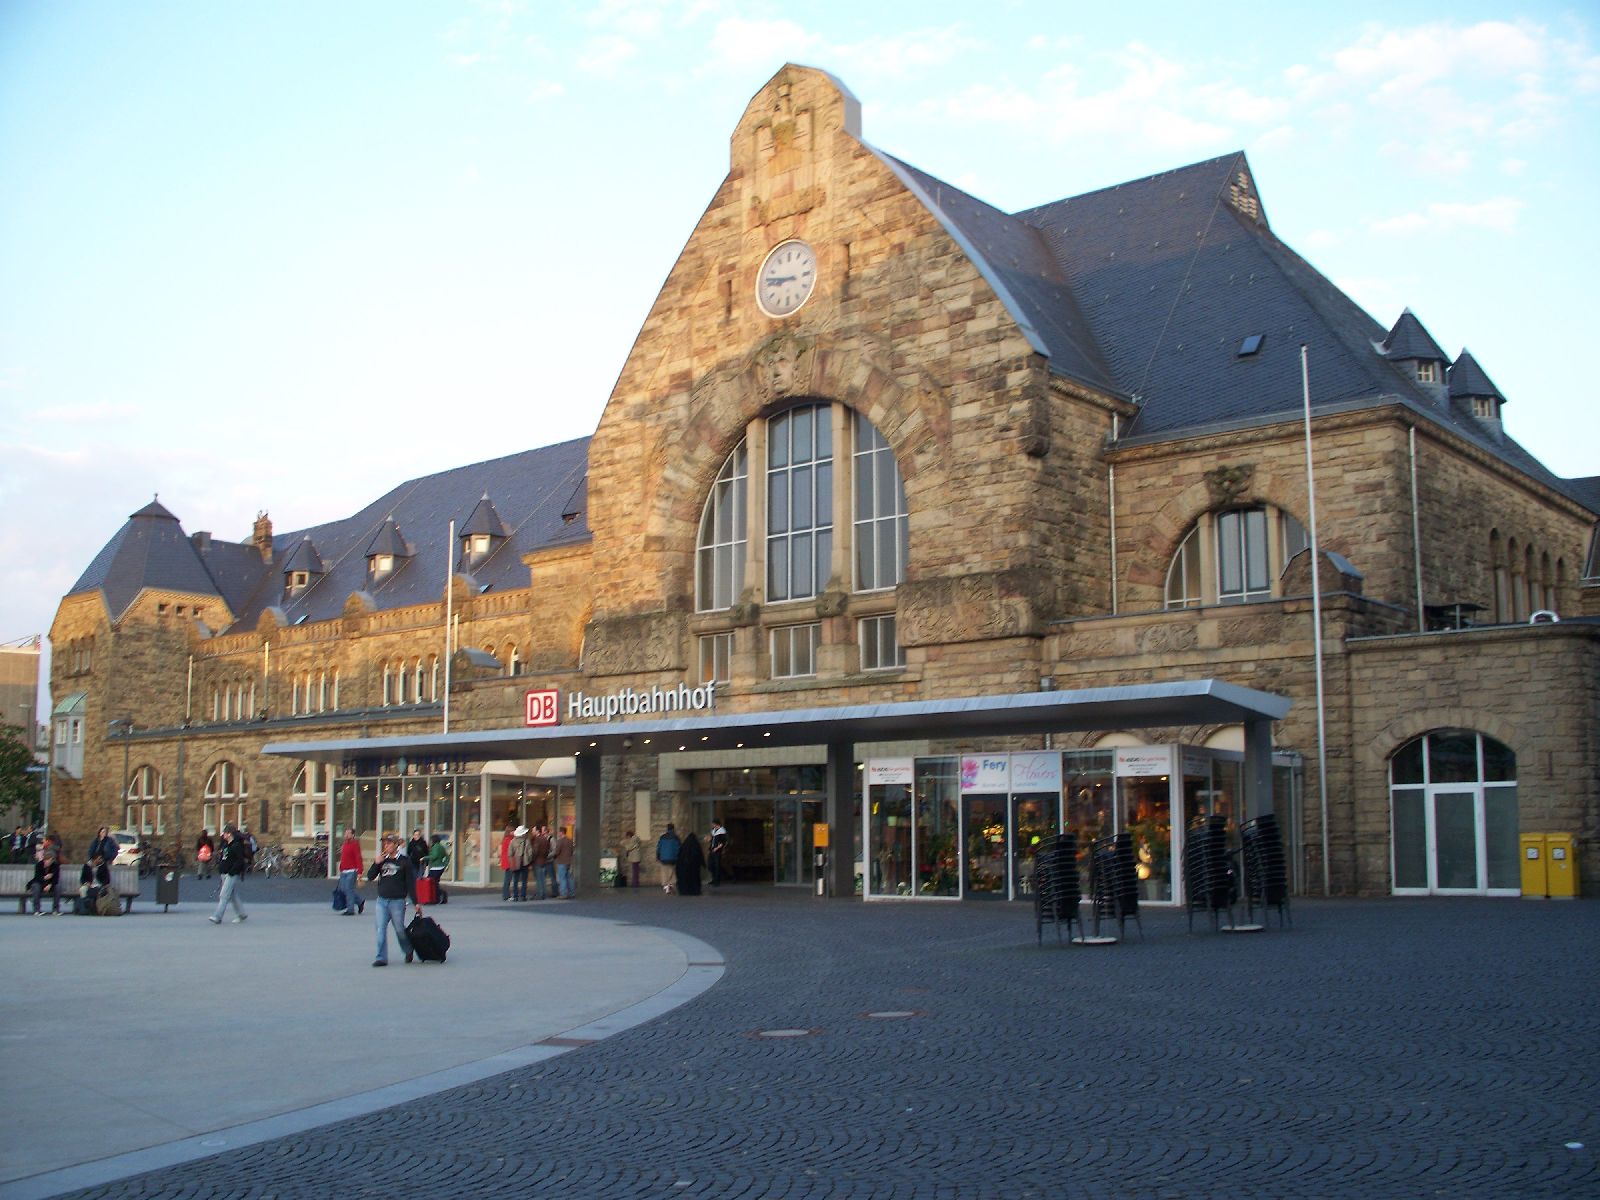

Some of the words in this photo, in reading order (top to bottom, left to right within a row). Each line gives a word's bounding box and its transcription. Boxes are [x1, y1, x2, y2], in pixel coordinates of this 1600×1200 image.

[529, 694, 555, 721] DB
[568, 680, 716, 722] Hauptbahnhof
[982, 759, 1007, 772] Fery
